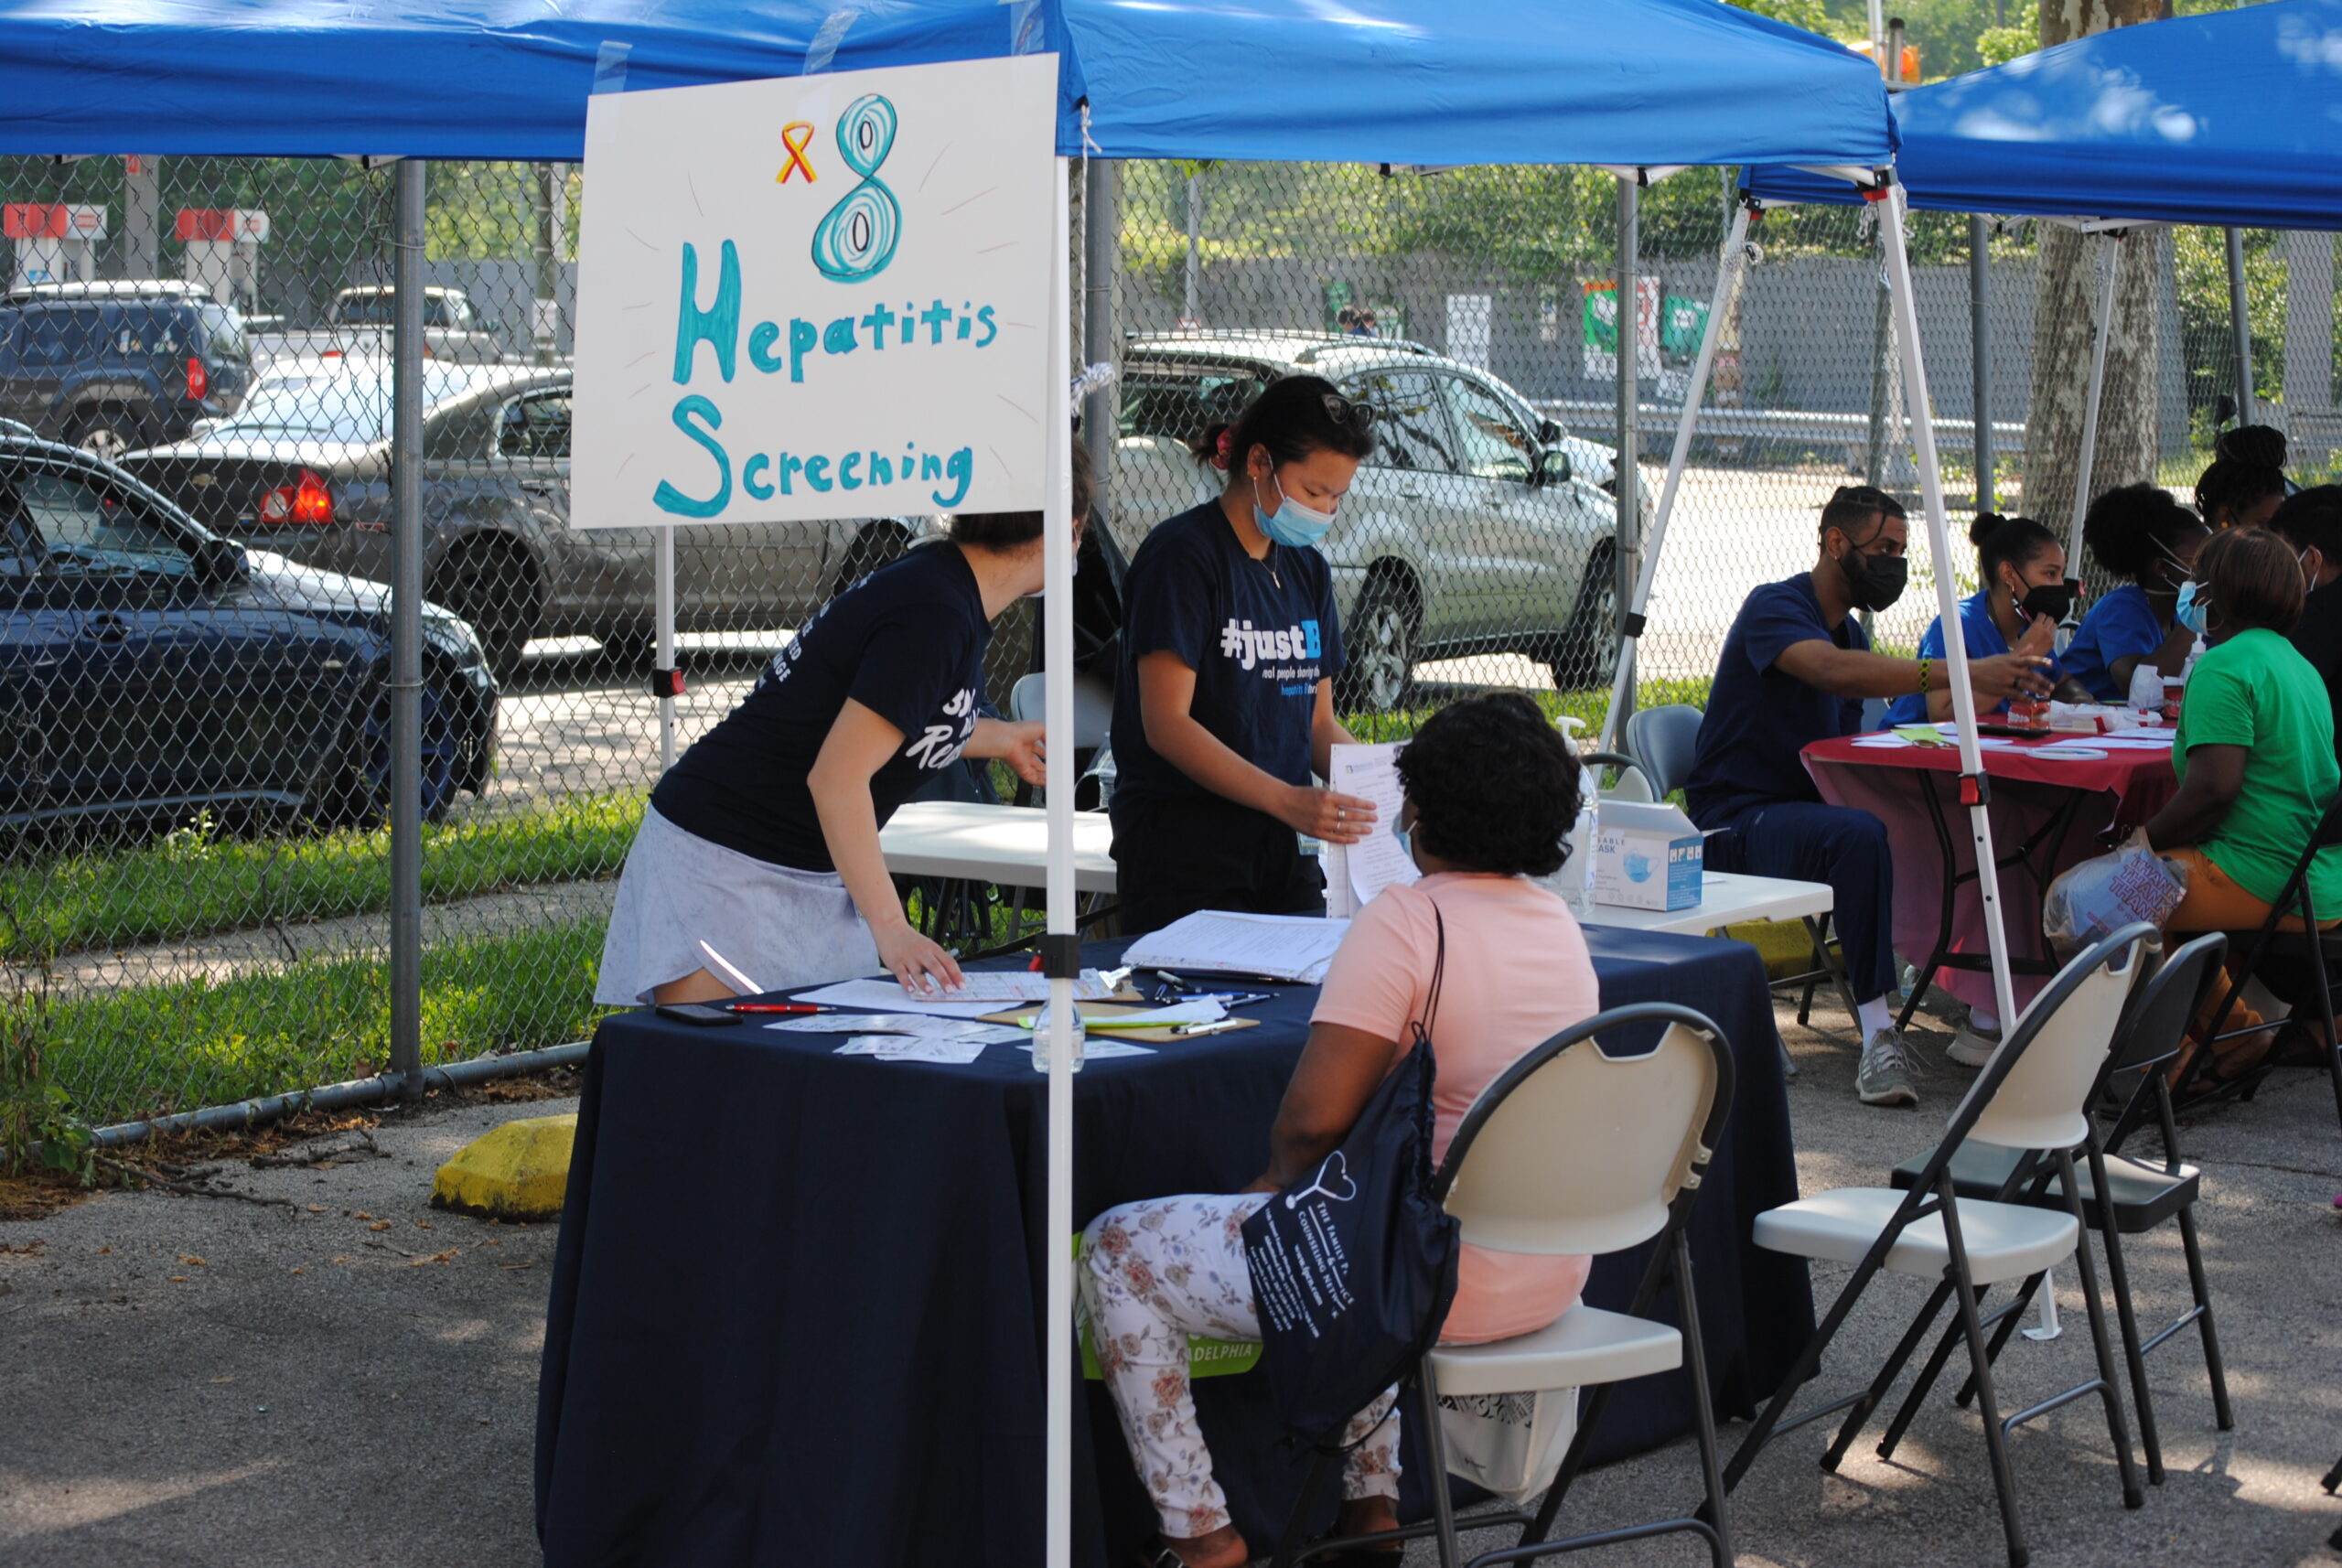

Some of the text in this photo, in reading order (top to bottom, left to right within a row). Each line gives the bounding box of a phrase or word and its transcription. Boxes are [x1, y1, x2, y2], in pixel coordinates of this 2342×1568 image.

[811, 93, 902, 285] 8
[672, 239, 997, 385] Hepatitis
[652, 394, 972, 518] Screening
[1220, 618, 1322, 671] #justB
[1276, 666, 1295, 681] people
[1598, 843, 1616, 854] ASK
[1298, 1210, 1327, 1273] COUNSELING
[1316, 1200, 1331, 1223] THE
[1327, 1224, 1346, 1261] FAMILY
